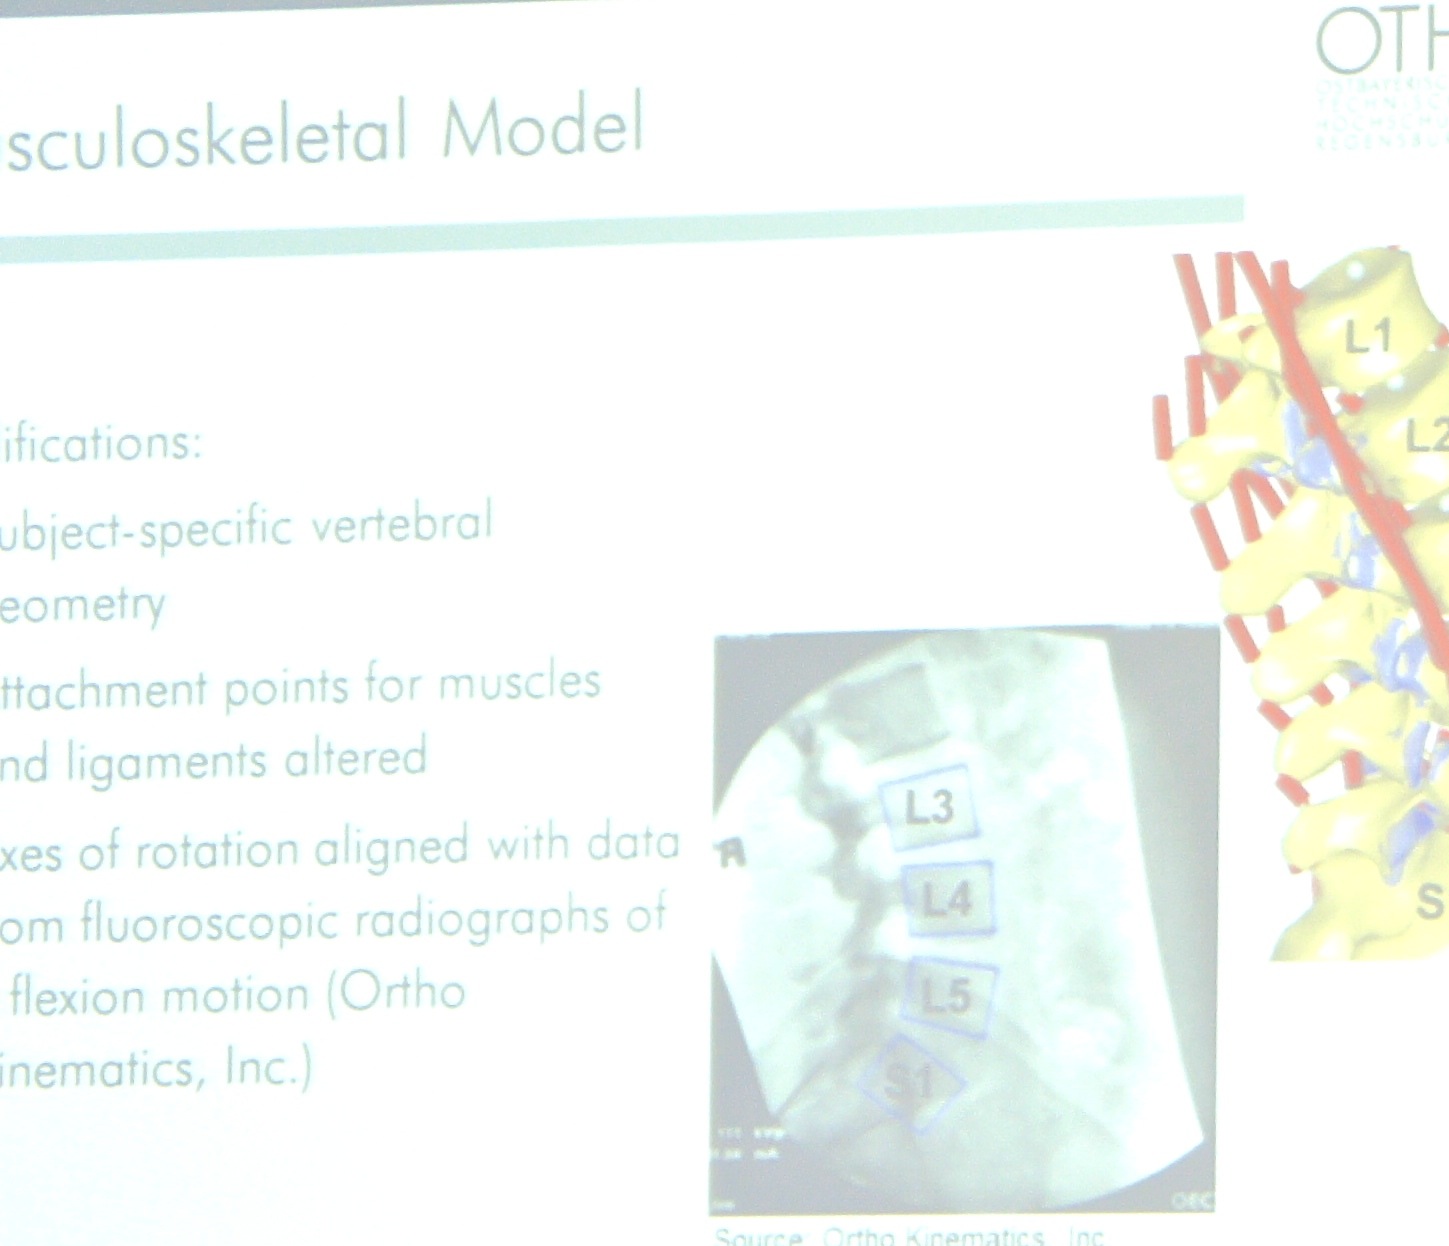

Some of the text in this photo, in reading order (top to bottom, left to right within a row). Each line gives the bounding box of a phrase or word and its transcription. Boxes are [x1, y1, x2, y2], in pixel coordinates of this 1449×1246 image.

[443, 86, 642, 158] Model
[1345, 316, 1391, 354] L1
[4, 419, 201, 464] ifications:
[0, 496, 493, 560] ubject-specific vertebral
[0, 586, 166, 631] eometry
[0, 656, 602, 715] ttachment points for muscles
[0, 731, 427, 792] nd ligaments altered
[904, 788, 955, 827] L3
[0, 817, 680, 877] xes of rotation aligned with data
[0, 888, 667, 950] om fluoroscopic radiographs of
[921, 880, 973, 919] L4
[10, 966, 466, 1020] flexion motion (Ortho
[921, 976, 973, 1017] L5
[0, 1041, 312, 1094] inematics, Inc.)
[882, 1058, 934, 1100] S1
